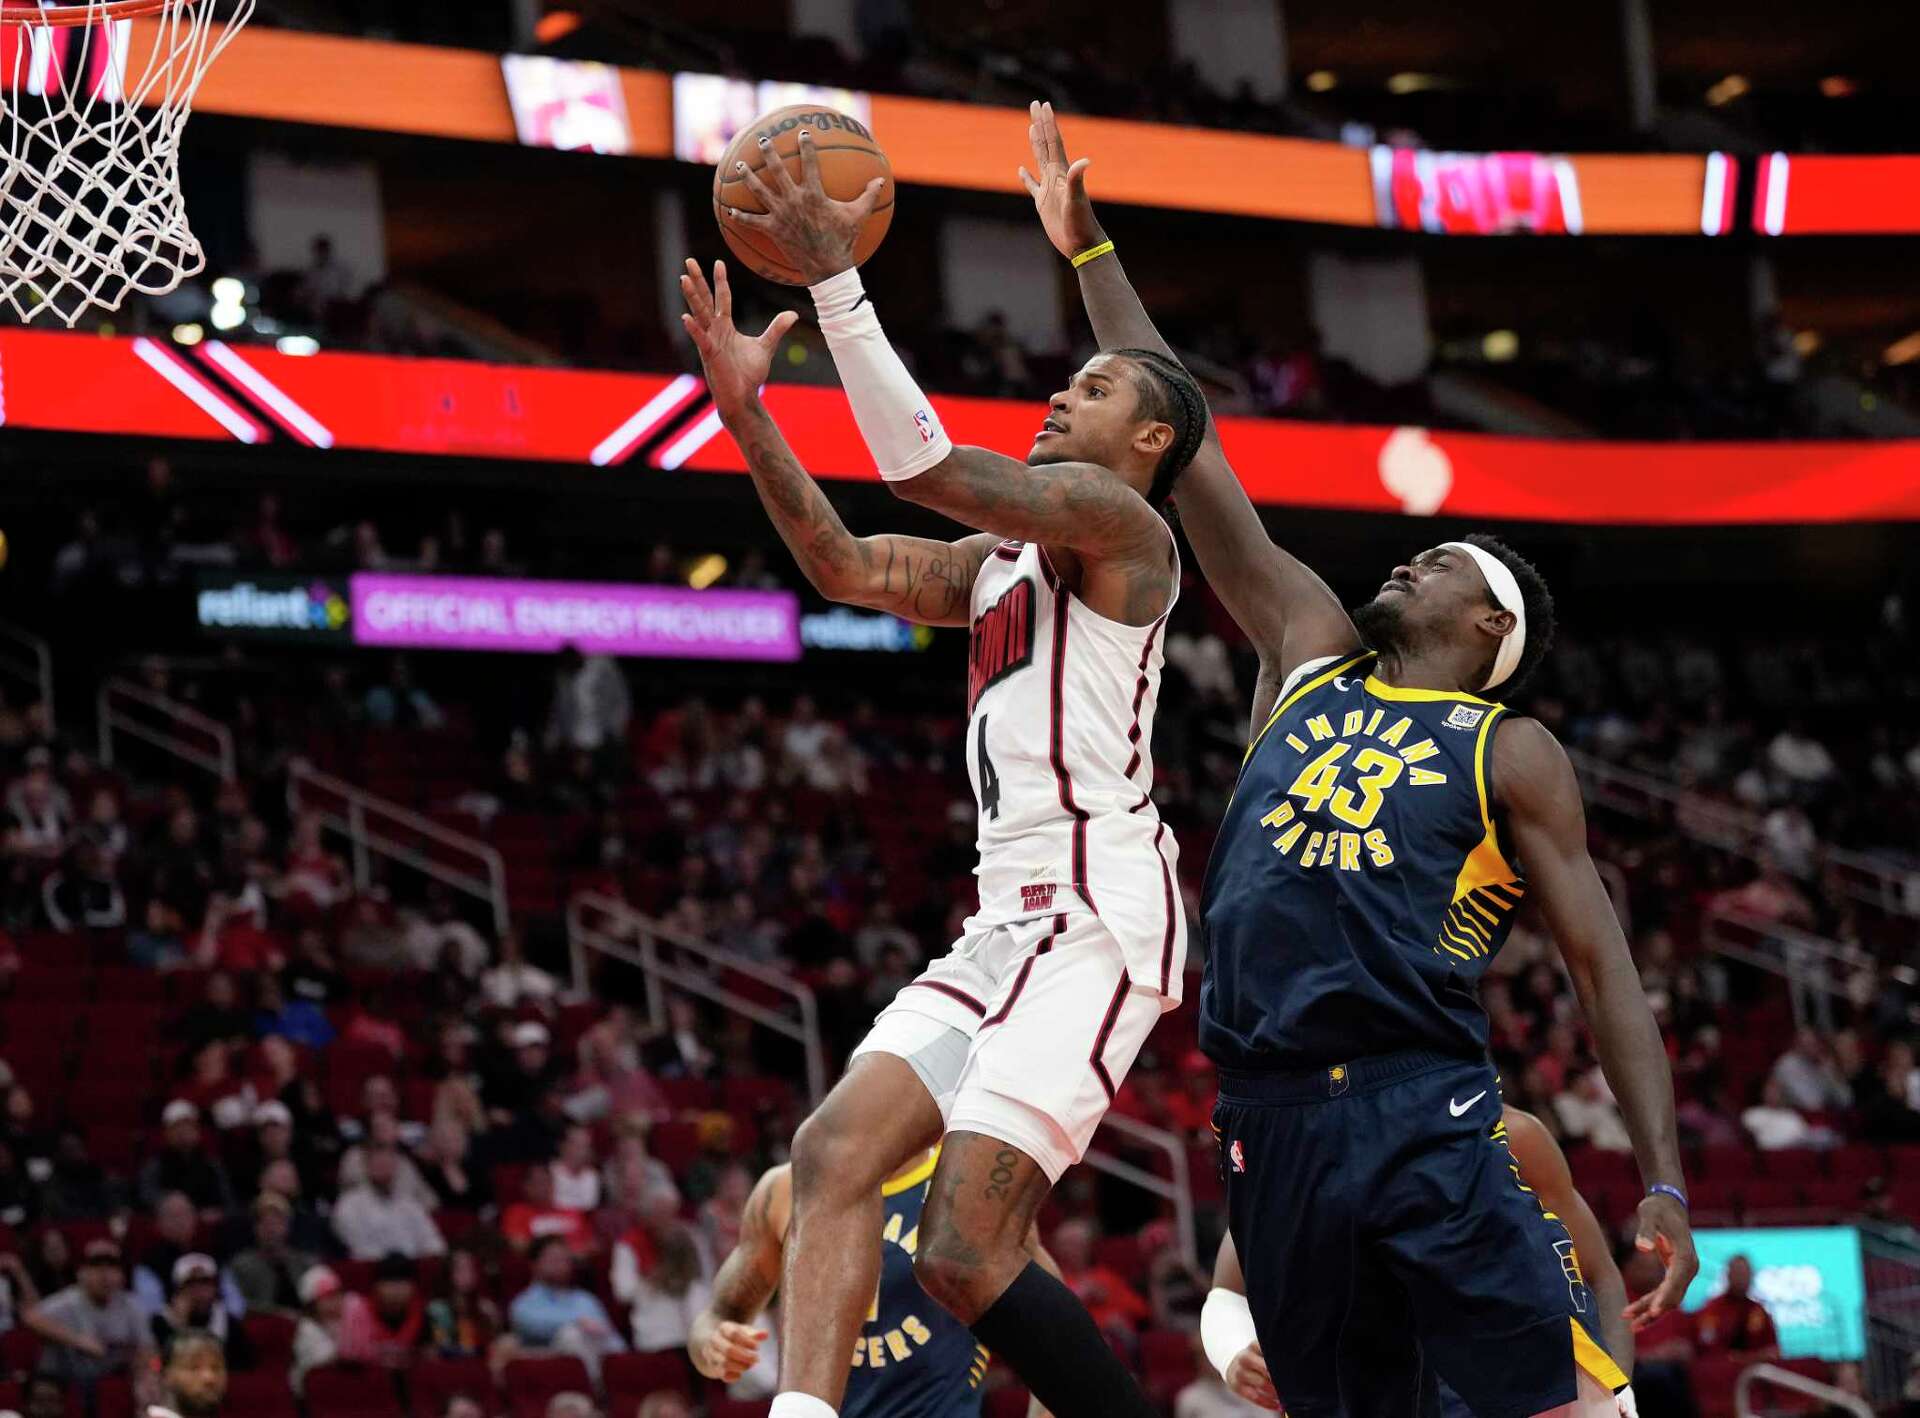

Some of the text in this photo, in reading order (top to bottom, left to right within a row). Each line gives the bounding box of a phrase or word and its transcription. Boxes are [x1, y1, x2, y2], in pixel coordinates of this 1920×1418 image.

[756, 112, 874, 143] Wilson
[198, 582, 311, 629] reliant
[363, 590, 785, 644] OFFICIAL ENERGY PROVIDER
[801, 608, 899, 651] reliant
[978, 713, 1000, 821] 4
[1285, 709, 1447, 785] INDIANA
[1287, 742, 1404, 829] 43
[1260, 800, 1394, 872] PACERS
[851, 1315, 931, 1368] CERS
